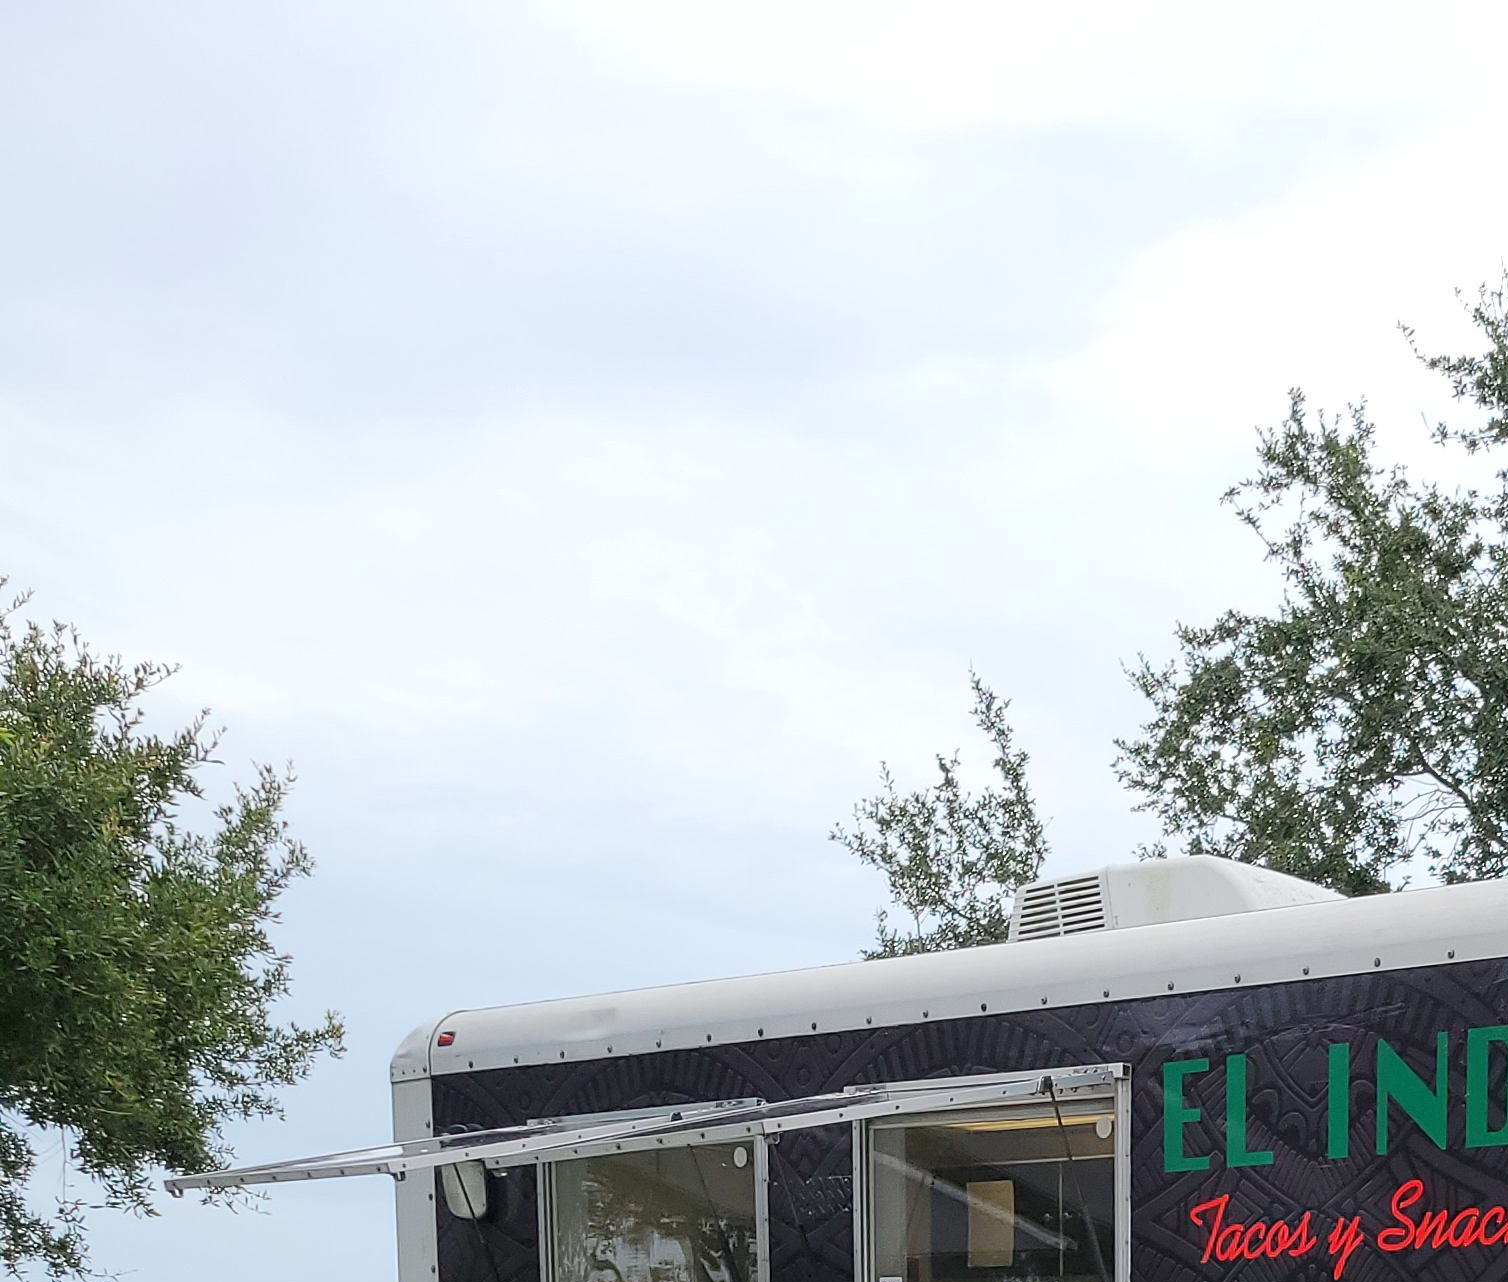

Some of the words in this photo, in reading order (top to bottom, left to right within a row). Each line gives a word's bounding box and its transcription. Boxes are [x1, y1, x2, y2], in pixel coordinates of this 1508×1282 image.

[1163, 1053, 1273, 1172] EL
[1190, 1194, 1317, 1263] Tacos
[1328, 1216, 1365, 1281] y
